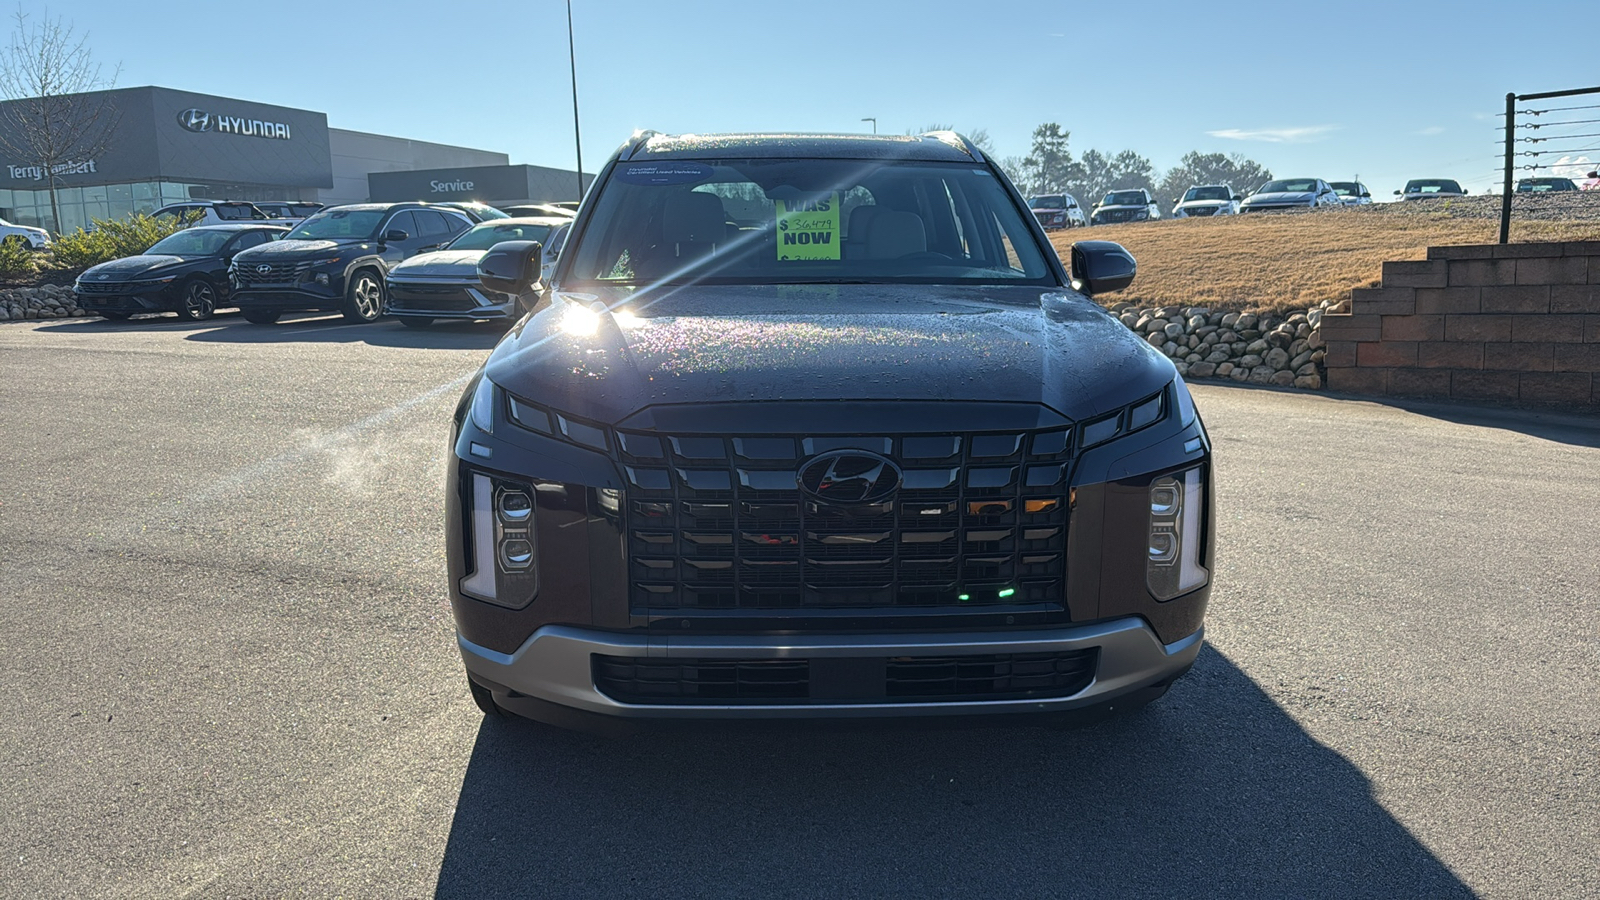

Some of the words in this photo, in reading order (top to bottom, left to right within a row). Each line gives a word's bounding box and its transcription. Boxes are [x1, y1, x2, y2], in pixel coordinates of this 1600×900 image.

[218, 115, 291, 140] HYUNDAI
[7, 164, 42, 181] Terry
[430, 179, 474, 193] Service
[784, 199, 831, 212] WAS
[783, 231, 832, 245] NOW
